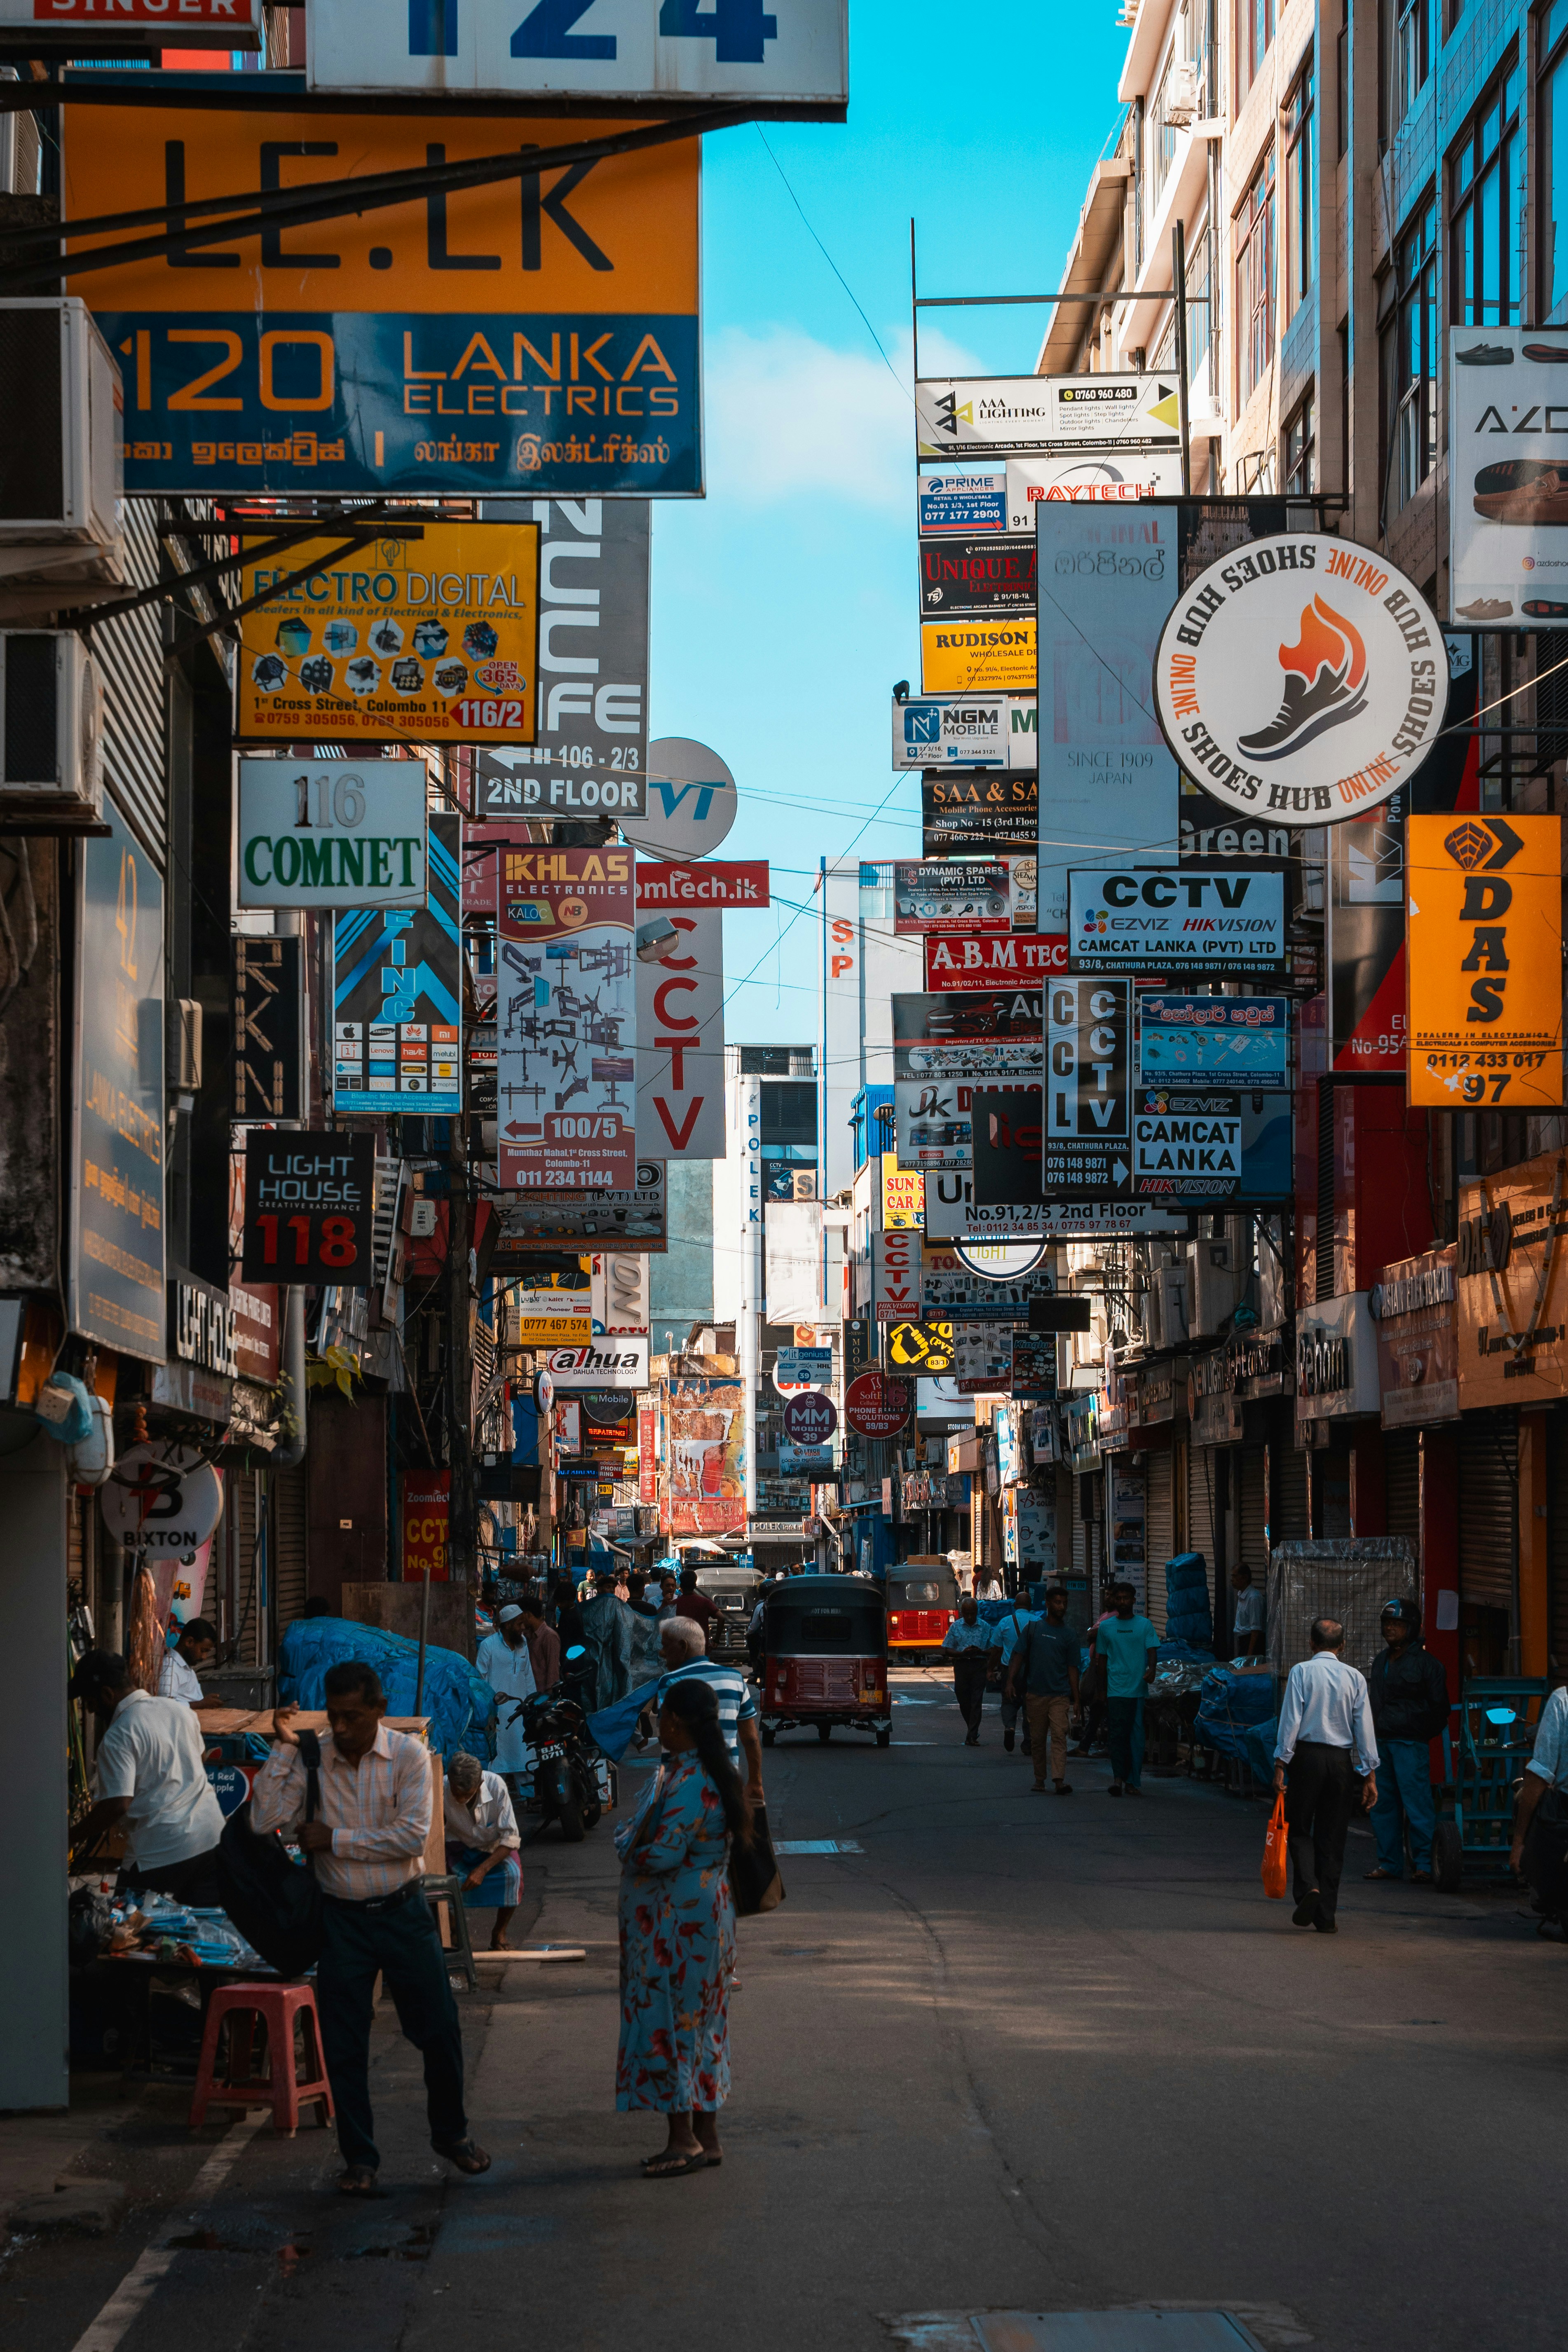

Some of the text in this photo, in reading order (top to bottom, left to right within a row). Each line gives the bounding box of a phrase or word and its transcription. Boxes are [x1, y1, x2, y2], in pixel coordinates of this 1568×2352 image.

[403, 331, 677, 382] LANKA
[119, 329, 334, 411] 120
[403, 385, 678, 416] ELECTRICS
[1075, 389, 1132, 400] 0760 960 480
[979, 398, 1005, 408] AAA
[980, 407, 1045, 419] LIGHTING
[945, 477, 994, 487] PRIME
[1027, 483, 1155, 502] RAYTECH
[925, 512, 945, 521] 077
[973, 510, 1000, 519] 2900
[924, 553, 1020, 581] UNIQUE
[1221, 545, 1316, 593] SHOES
[253, 570, 525, 607] ELECTRO DIGITAL
[1176, 585, 1226, 648] HUB
[936, 632, 1028, 648] RUDISON
[970, 649, 1024, 658] WHOLESALE
[1325, 548, 1435, 757] SHOES HUB ONLINE
[489, 662, 517, 670] OPEN
[482, 670, 517, 683] 365
[1170, 654, 1200, 720] ONLINE
[273, 698, 311, 710] Cross
[316, 698, 362, 713] Street,
[367, 699, 426, 712] Colombo
[431, 701, 447, 712] 11
[460, 700, 522, 727] 116/2
[943, 710, 998, 723] NGM
[944, 725, 998, 735] MOBILE
[559, 745, 593, 769] 106
[611, 747, 639, 770] 2/3
[1068, 752, 1153, 768] SINCE 1909
[1181, 722, 1401, 811] SHOES HUB ONLINE
[1089, 772, 1132, 785] JAPAN
[294, 774, 366, 828] 116
[488, 779, 638, 807] 2ND FLOOR
[933, 783, 1005, 803] SAA &
[1181, 819, 1289, 858] Green
[244, 836, 422, 887] COMNET
[506, 854, 628, 881] IKHLAS
[919, 867, 963, 876] DYNAMIC
[940, 876, 965, 886] (PVT)
[506, 886, 628, 895] ELECTRONICS
[1103, 876, 1251, 908] CCTV
[507, 907, 548, 919] KALOC
[1111, 918, 1277, 932] EZVIZ HIKVISION
[932, 940, 1018, 969] A.B.M
[1078, 939, 1276, 954] CAMCAT LANKA (PVT) LTD
[1459, 876, 1512, 1022] DAS
[1079, 960, 1104, 970] 93/8,
[382, 939, 415, 1023] INC
[1088, 991, 1116, 1127] CCTV
[1427, 1054, 1545, 1067] 0112 433 017
[1463, 1074, 1512, 1102] 97
[1170, 1098, 1230, 1111] EZVIZ
[551, 1117, 616, 1138] 100/5
[1137, 1121, 1239, 1144] CAMCAT
[602, 1149, 628, 1158] Street,
[1140, 1149, 1236, 1171] LANKA
[269, 1154, 354, 1176] LIGHT
[546, 1160, 590, 1168] Colombo-11
[748, 1115, 760, 1222] POLEK
[517, 1171, 613, 1185] 011 234 1144
[887, 1178, 915, 1192] SUN
[259, 1180, 361, 1202] HOUSE
[1139, 1179, 1235, 1194] HIKVISION
[887, 1195, 914, 1210] CAR
[1059, 1204, 1093, 1218] 2nd
[1099, 1202, 1146, 1218] Floor
[255, 1215, 357, 1267] 118
[884, 1234, 911, 1301] CCTV
[879, 1310, 895, 1318] 87/1
[524, 1319, 587, 1330] 0777 467 574
[599, 1395, 628, 1403] Mobile
[792, 1408, 829, 1424] MM
[803, 1433, 817, 1442] 39
[124, 1531, 197, 1546] BIXTON
